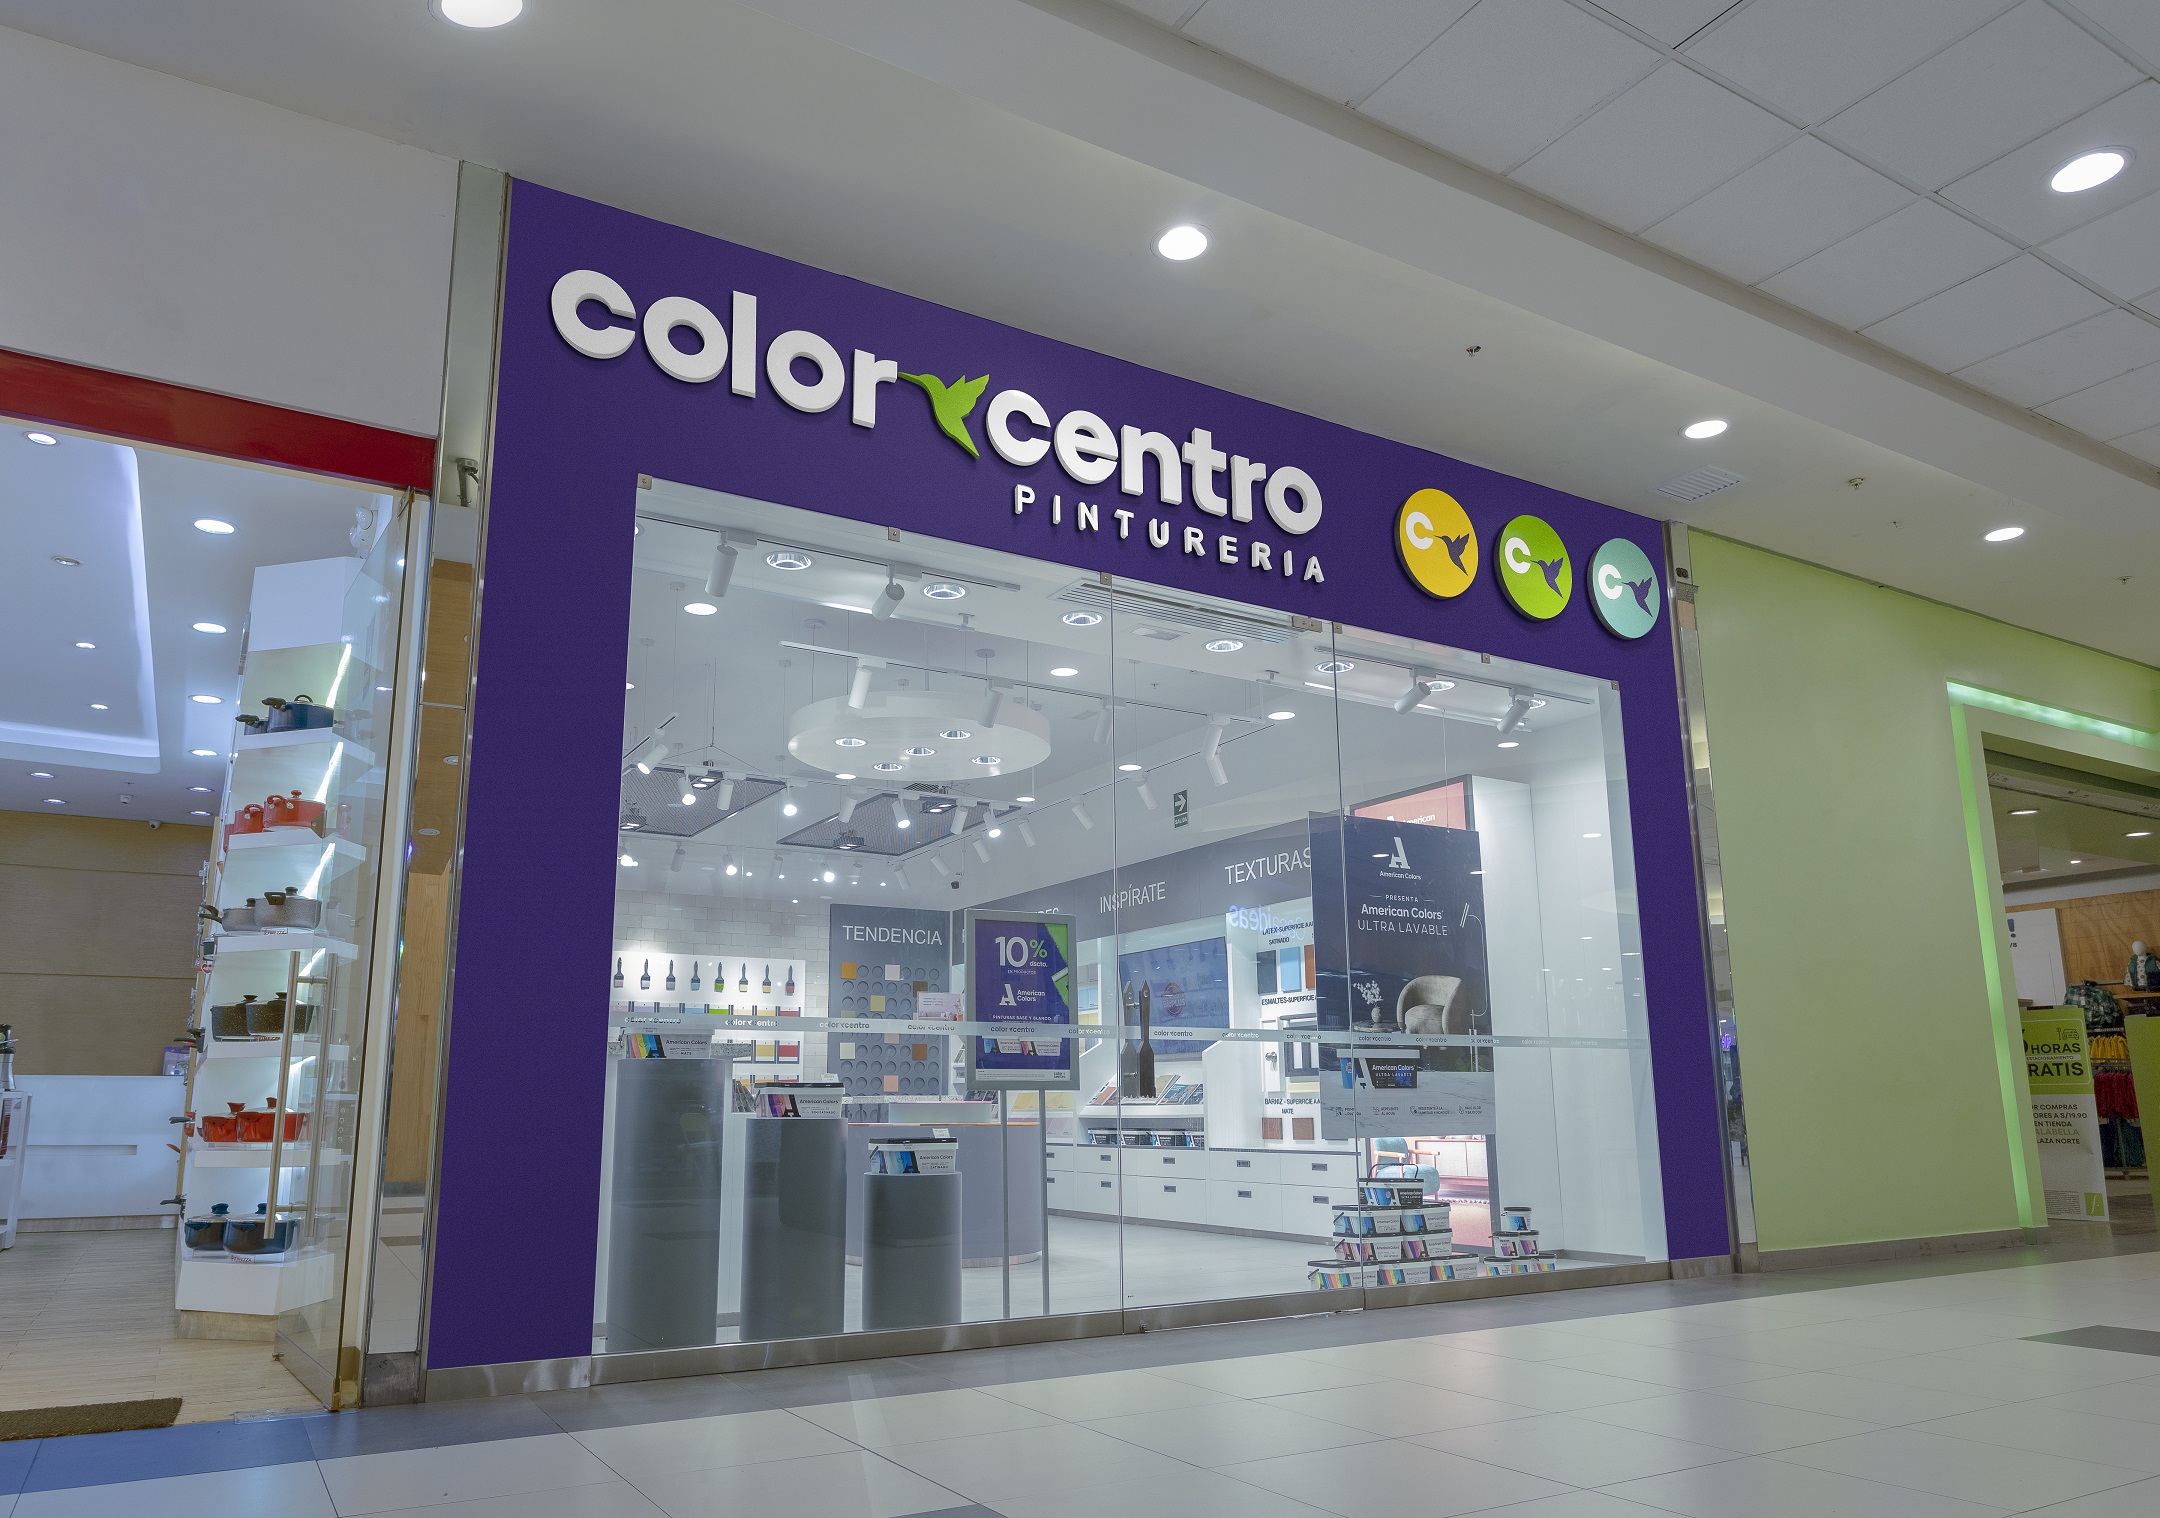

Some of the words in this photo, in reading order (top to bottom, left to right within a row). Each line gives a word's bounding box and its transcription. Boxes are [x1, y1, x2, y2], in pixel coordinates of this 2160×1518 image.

[550, 268, 898, 429] color
[985, 388, 1324, 535] centro
[1014, 483, 1325, 584] PINTURERIA
[1224, 846, 1311, 885] TEXTURAS
[1379, 870, 1405, 879] American
[1100, 881, 1166, 914] INSPÍRATE
[1385, 894, 1419, 903] PRESENTA
[1361, 903, 1410, 918] American
[1411, 907, 1443, 920] Colors
[1357, 919, 1396, 933] ULTRA
[1398, 922, 1448, 936] LAVABLE
[842, 925, 943, 946] TENDENCIA
[1016, 989, 1046, 997] American
[844, 1022, 870, 1030] centro
[990, 1025, 1009, 1033] color
[1013, 1026, 1036, 1034] centro
[1153, 1029, 1170, 1037] color
[2030, 1042, 2081, 1054] HORAS
[2027, 1062, 2084, 1077] RATIS
[2035, 1128, 2080, 1136] ALABELLA
